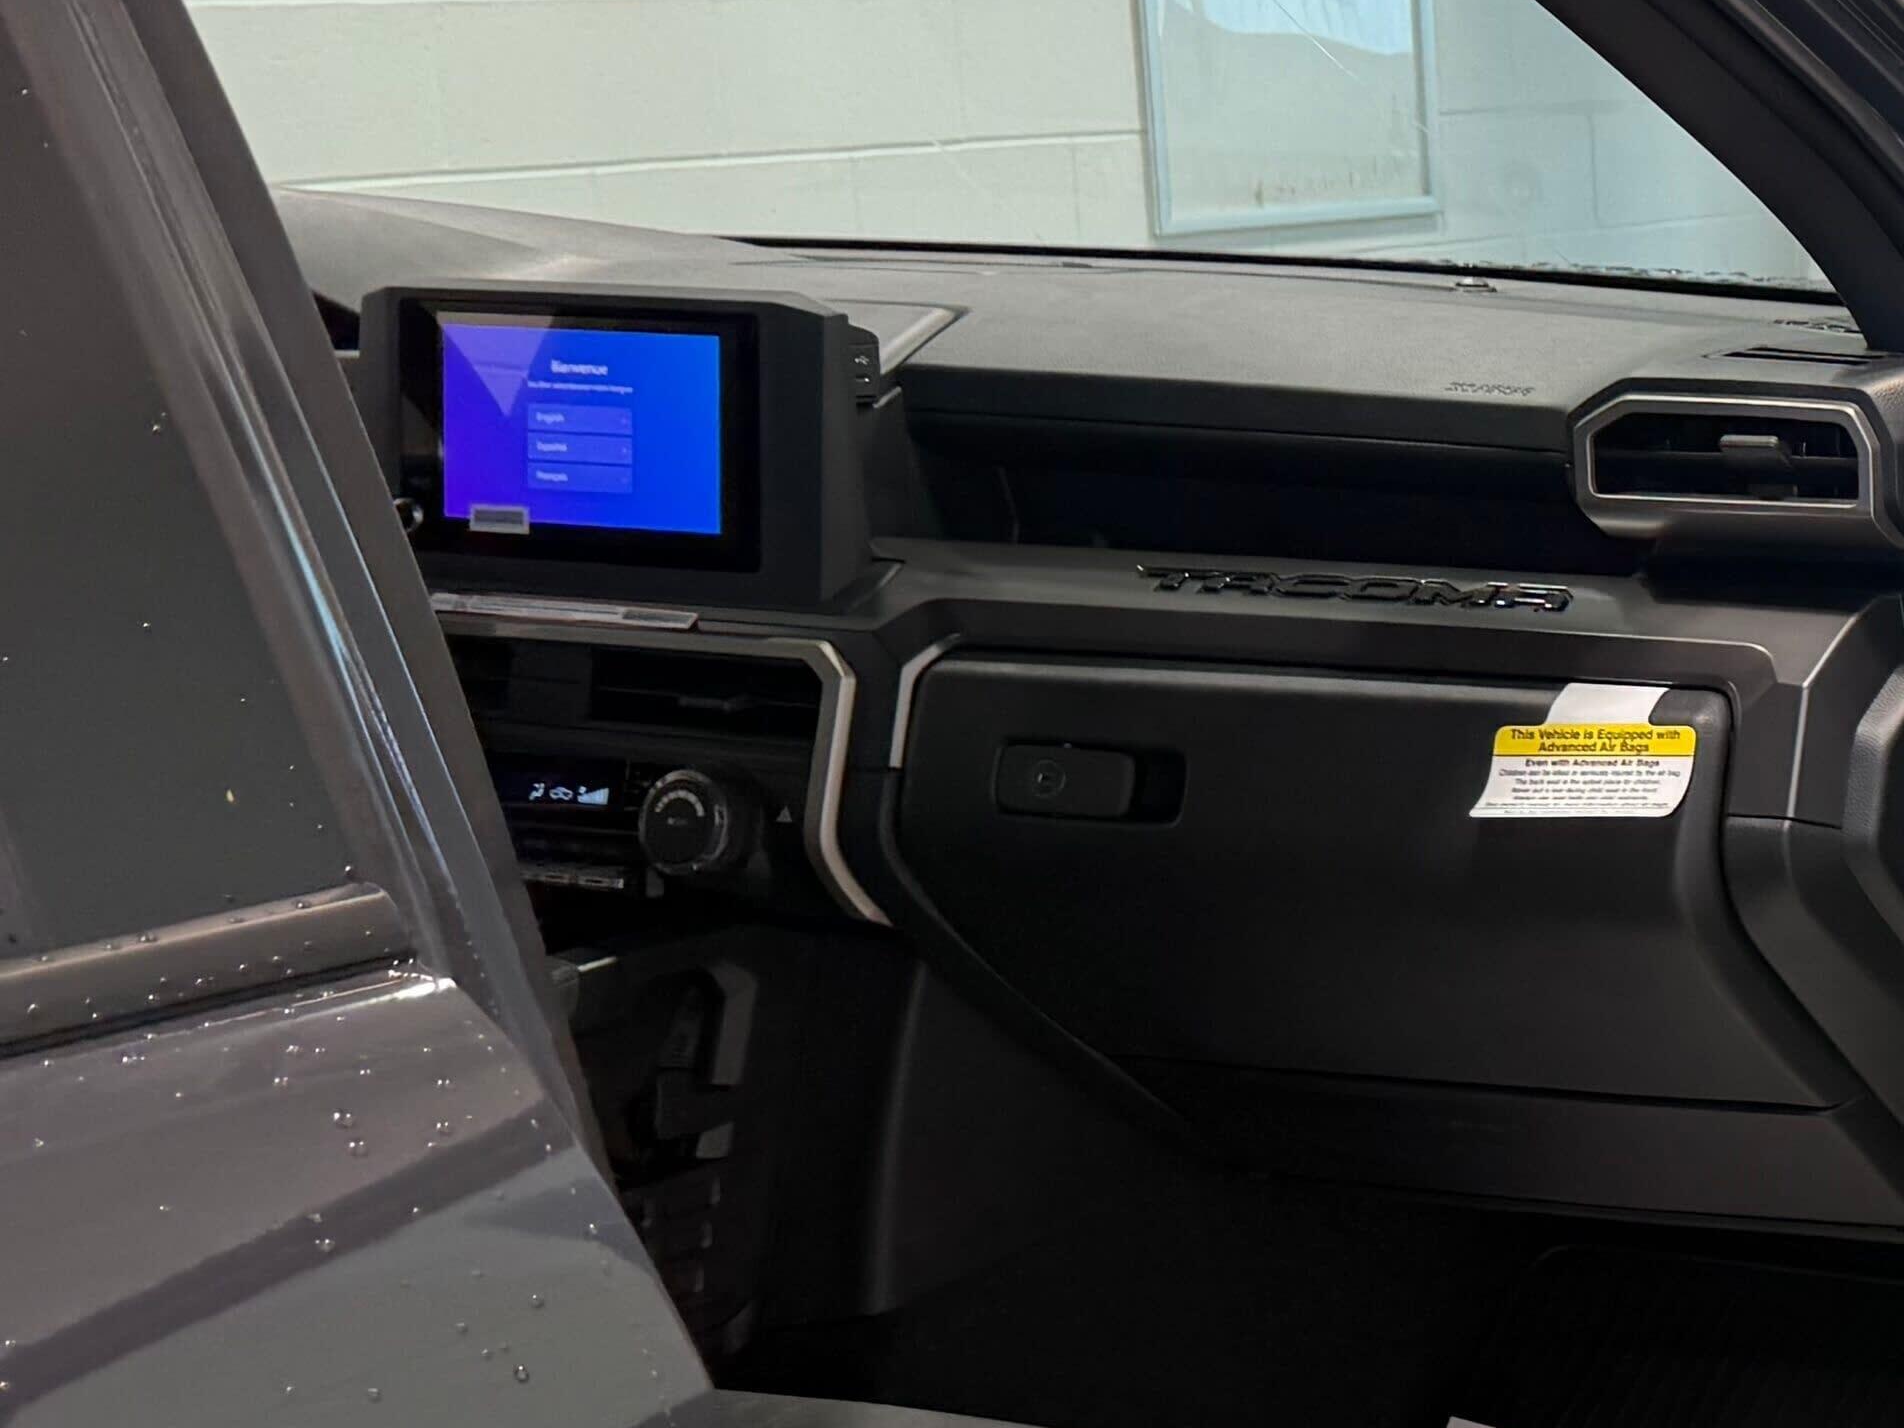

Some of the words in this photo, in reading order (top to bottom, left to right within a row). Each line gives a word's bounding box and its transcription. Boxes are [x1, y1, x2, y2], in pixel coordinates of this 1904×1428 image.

[1137, 566, 1573, 613] TACOMA
[1511, 728, 1535, 740] This
[1538, 728, 1581, 741] Vehicle
[1583, 728, 1594, 741] is
[1597, 729, 1653, 744] Equipped
[1656, 730, 1681, 741] with
[1538, 741, 1597, 753] Advanced
[1599, 742, 1617, 753] Air
[1620, 742, 1649, 755] Bags
